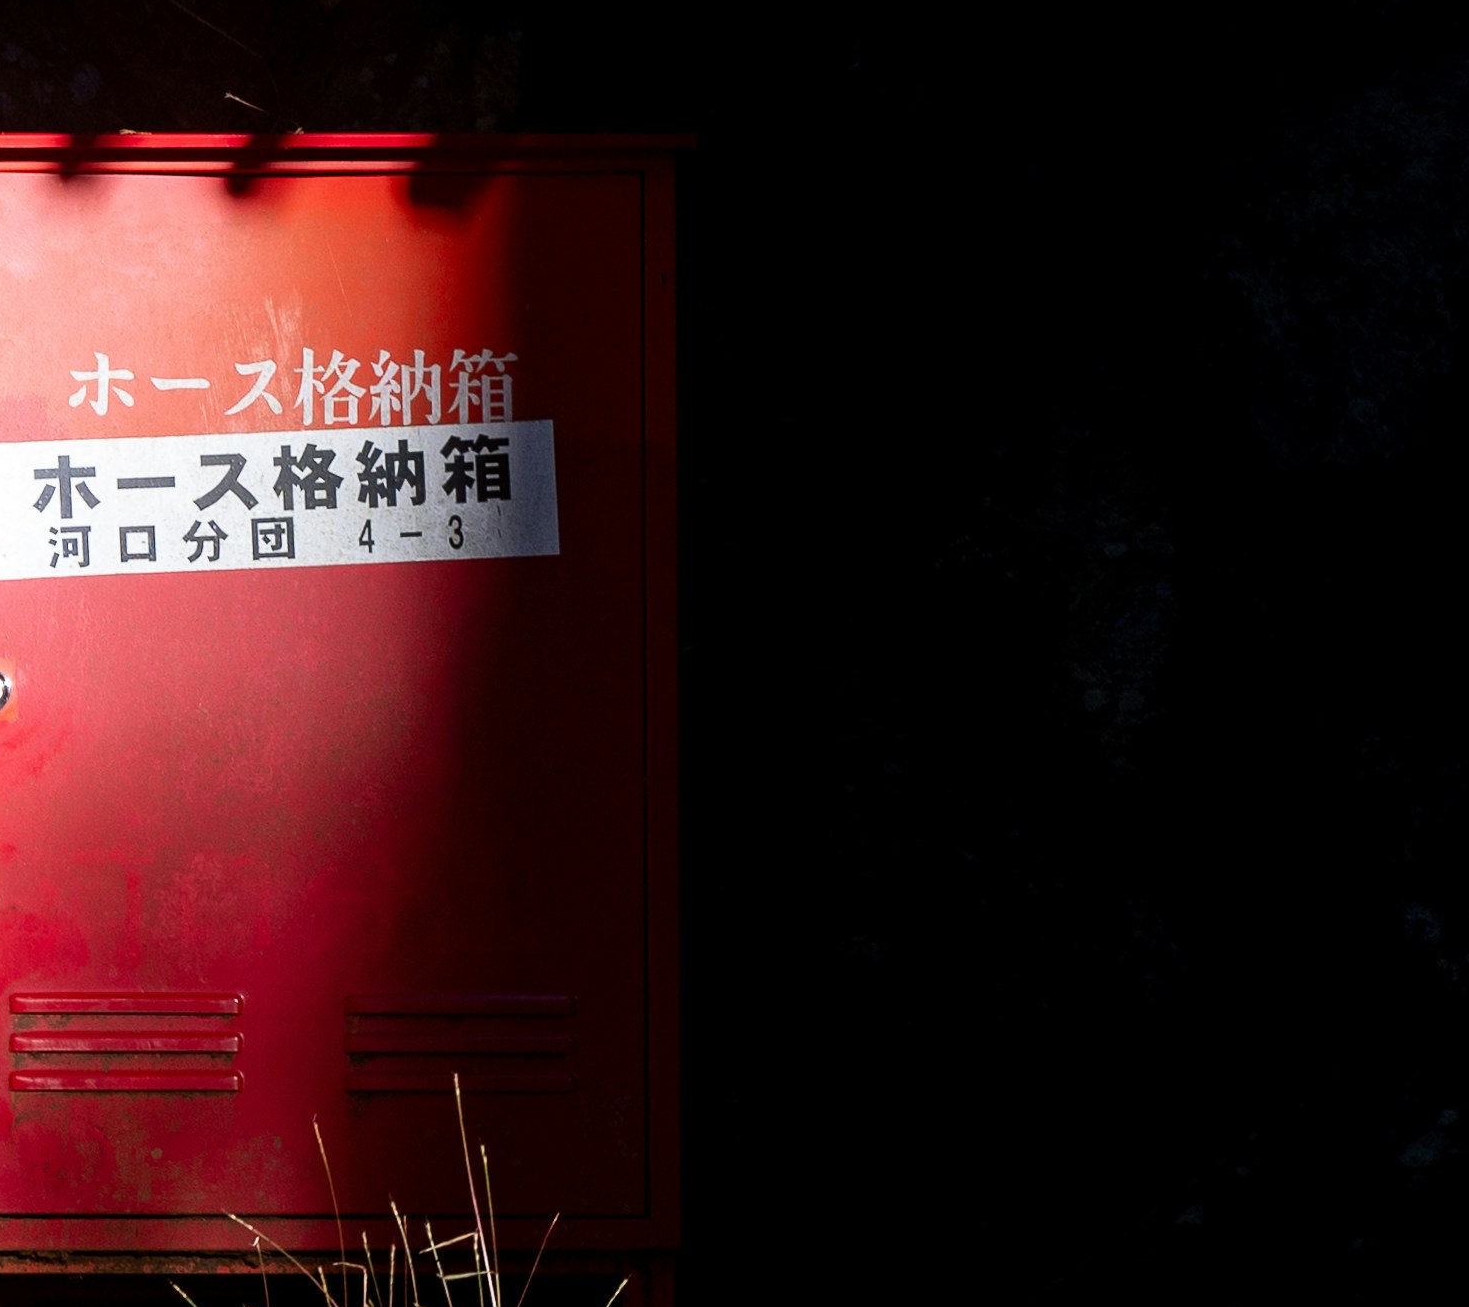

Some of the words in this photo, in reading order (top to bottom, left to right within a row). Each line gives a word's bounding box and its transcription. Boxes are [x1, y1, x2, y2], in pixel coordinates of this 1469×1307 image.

[67, 347, 519, 427] ホース格納箱
[31, 434, 513, 520] ホース格納箱
[47, 517, 297, 569] 河口分団
